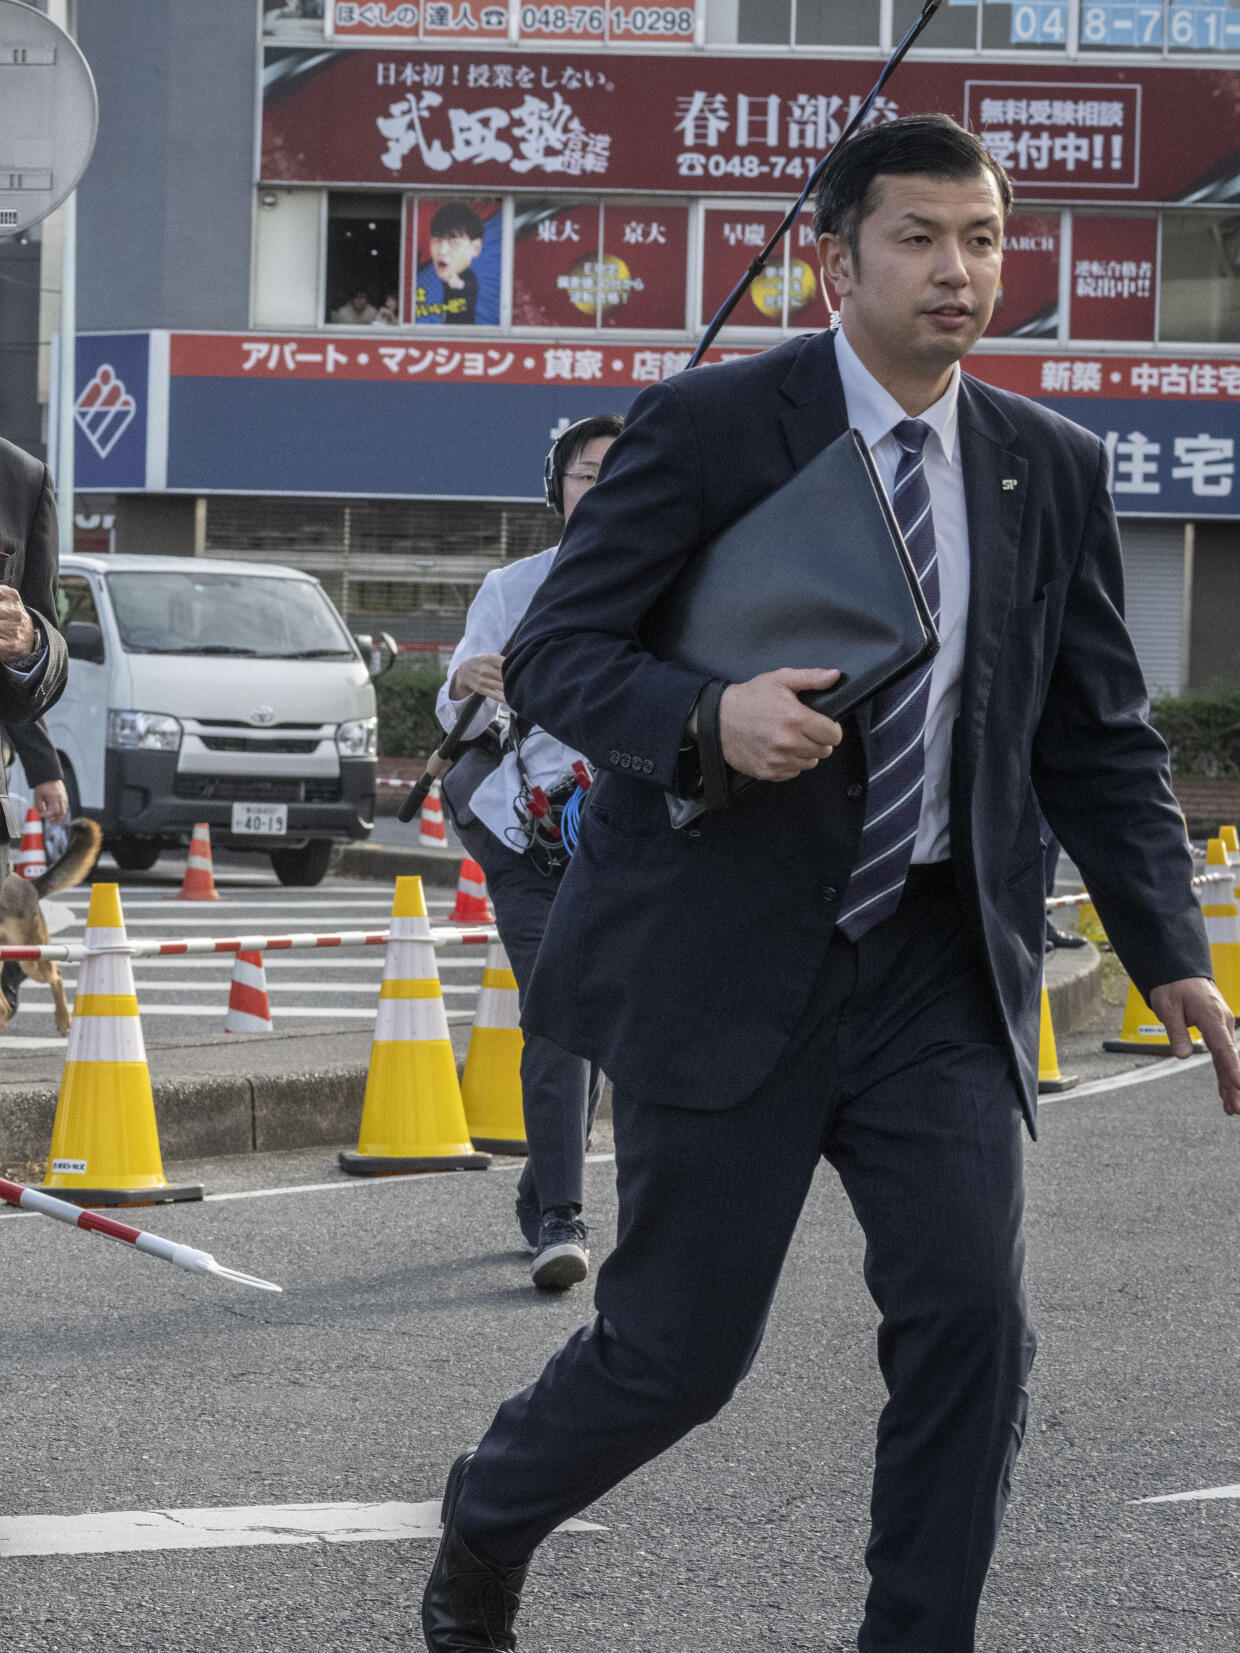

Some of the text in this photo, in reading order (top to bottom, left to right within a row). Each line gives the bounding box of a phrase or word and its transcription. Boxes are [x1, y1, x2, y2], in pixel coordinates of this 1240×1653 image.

[337, 4, 693, 32] ほぐしの 達人 048-761-0298
[980, 98, 1124, 127] 無料受験相談
[376, 90, 572, 173] 武田塾
[980, 130, 1123, 171] 受付中!!
[536, 220, 580, 242] 東大
